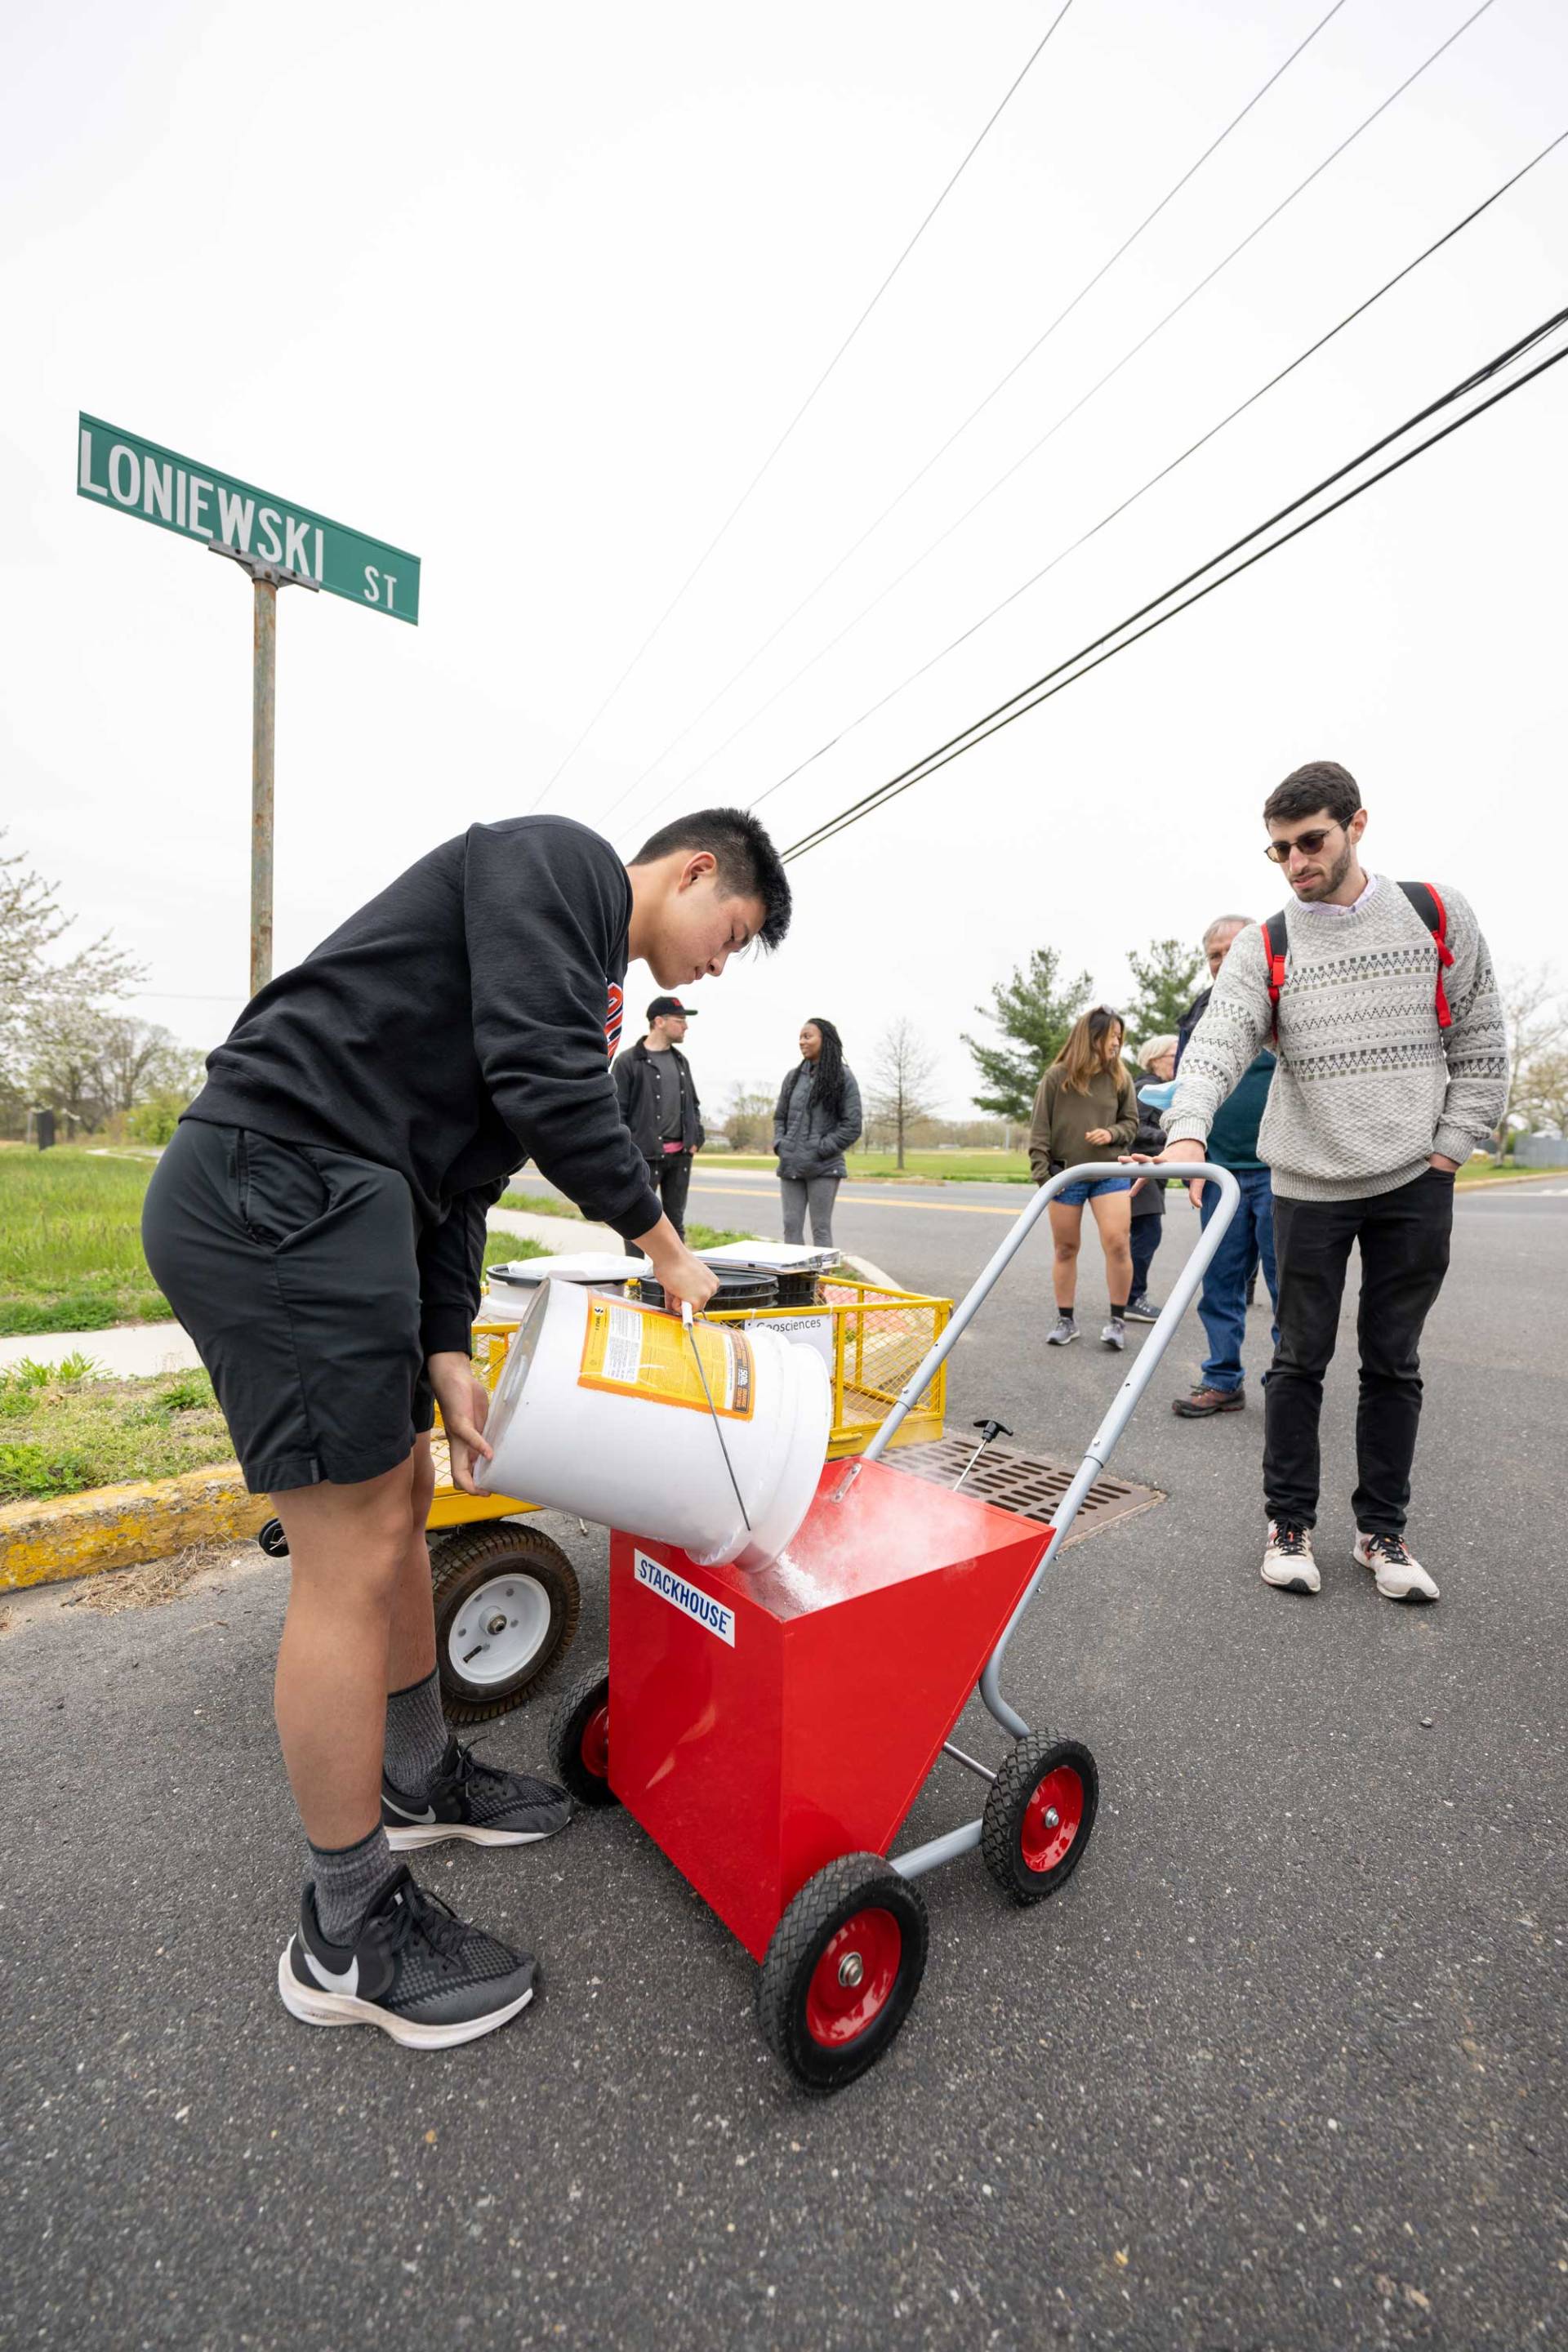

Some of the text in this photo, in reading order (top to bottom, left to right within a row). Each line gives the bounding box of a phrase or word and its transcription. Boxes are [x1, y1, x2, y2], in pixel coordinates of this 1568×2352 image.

[80, 429, 397, 609] LONIEWSKI ST
[637, 1559, 732, 1634] STACKHOUSE
